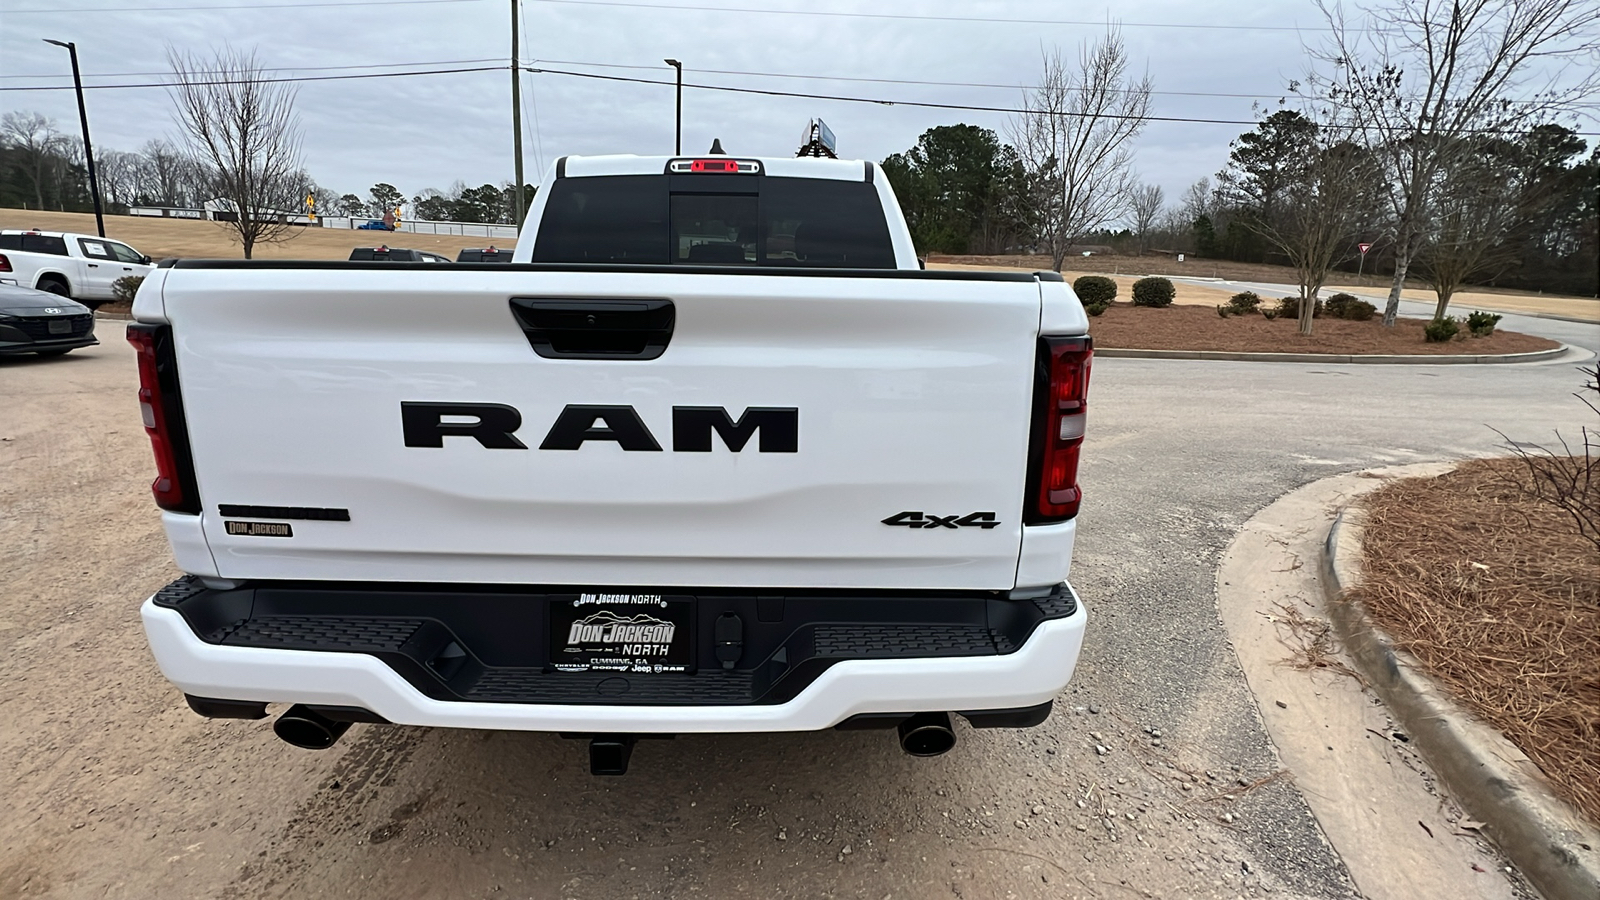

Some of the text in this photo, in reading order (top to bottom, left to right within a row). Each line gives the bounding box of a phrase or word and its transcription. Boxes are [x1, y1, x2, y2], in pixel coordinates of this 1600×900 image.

[400, 401, 799, 453] RAM
[880, 511, 1001, 529] 4x4
[229, 522, 288, 535] DON JACKSON
[580, 593, 661, 604] DON JACKSON NORTH
[567, 623, 676, 645] DON JACKSON
[622, 644, 669, 656] NORTH
[631, 664, 652, 674] Jeep
